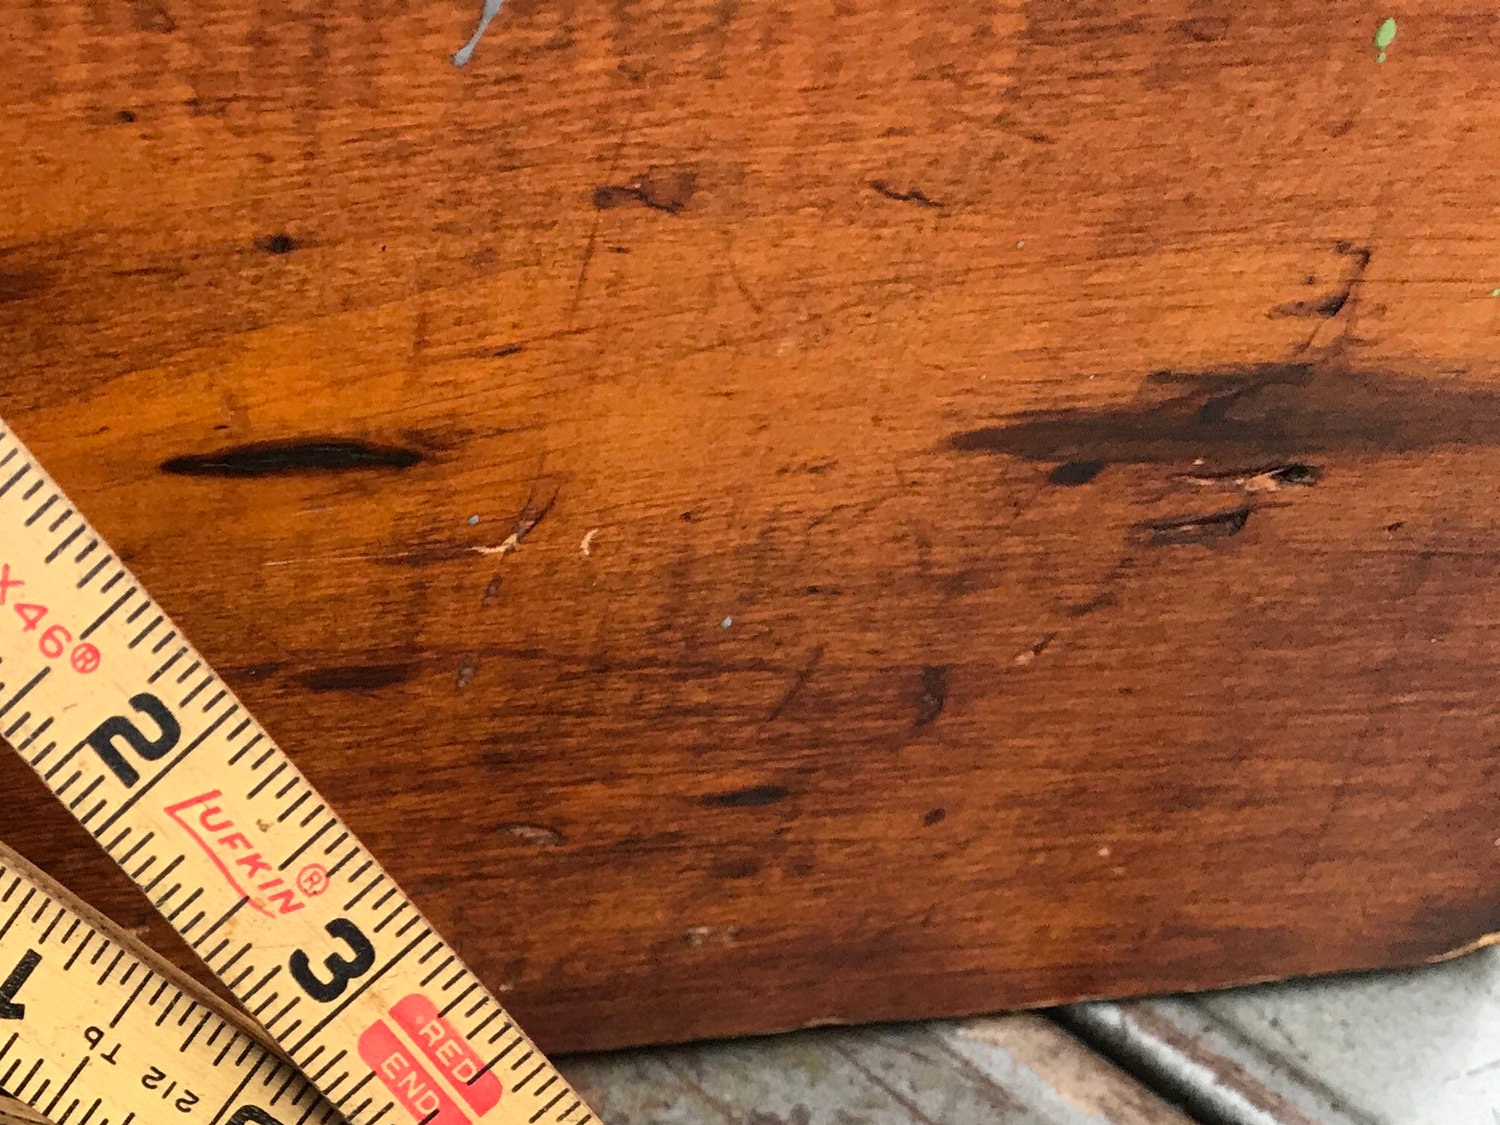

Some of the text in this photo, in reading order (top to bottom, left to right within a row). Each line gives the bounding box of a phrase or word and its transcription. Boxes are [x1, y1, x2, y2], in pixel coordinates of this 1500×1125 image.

[89, 692, 181, 789] 2
[288, 918, 376, 1004] 3
[380, 1051, 441, 1117] END
[418, 1018, 480, 1086] RED
[140, 1065, 200, 1114] 212
